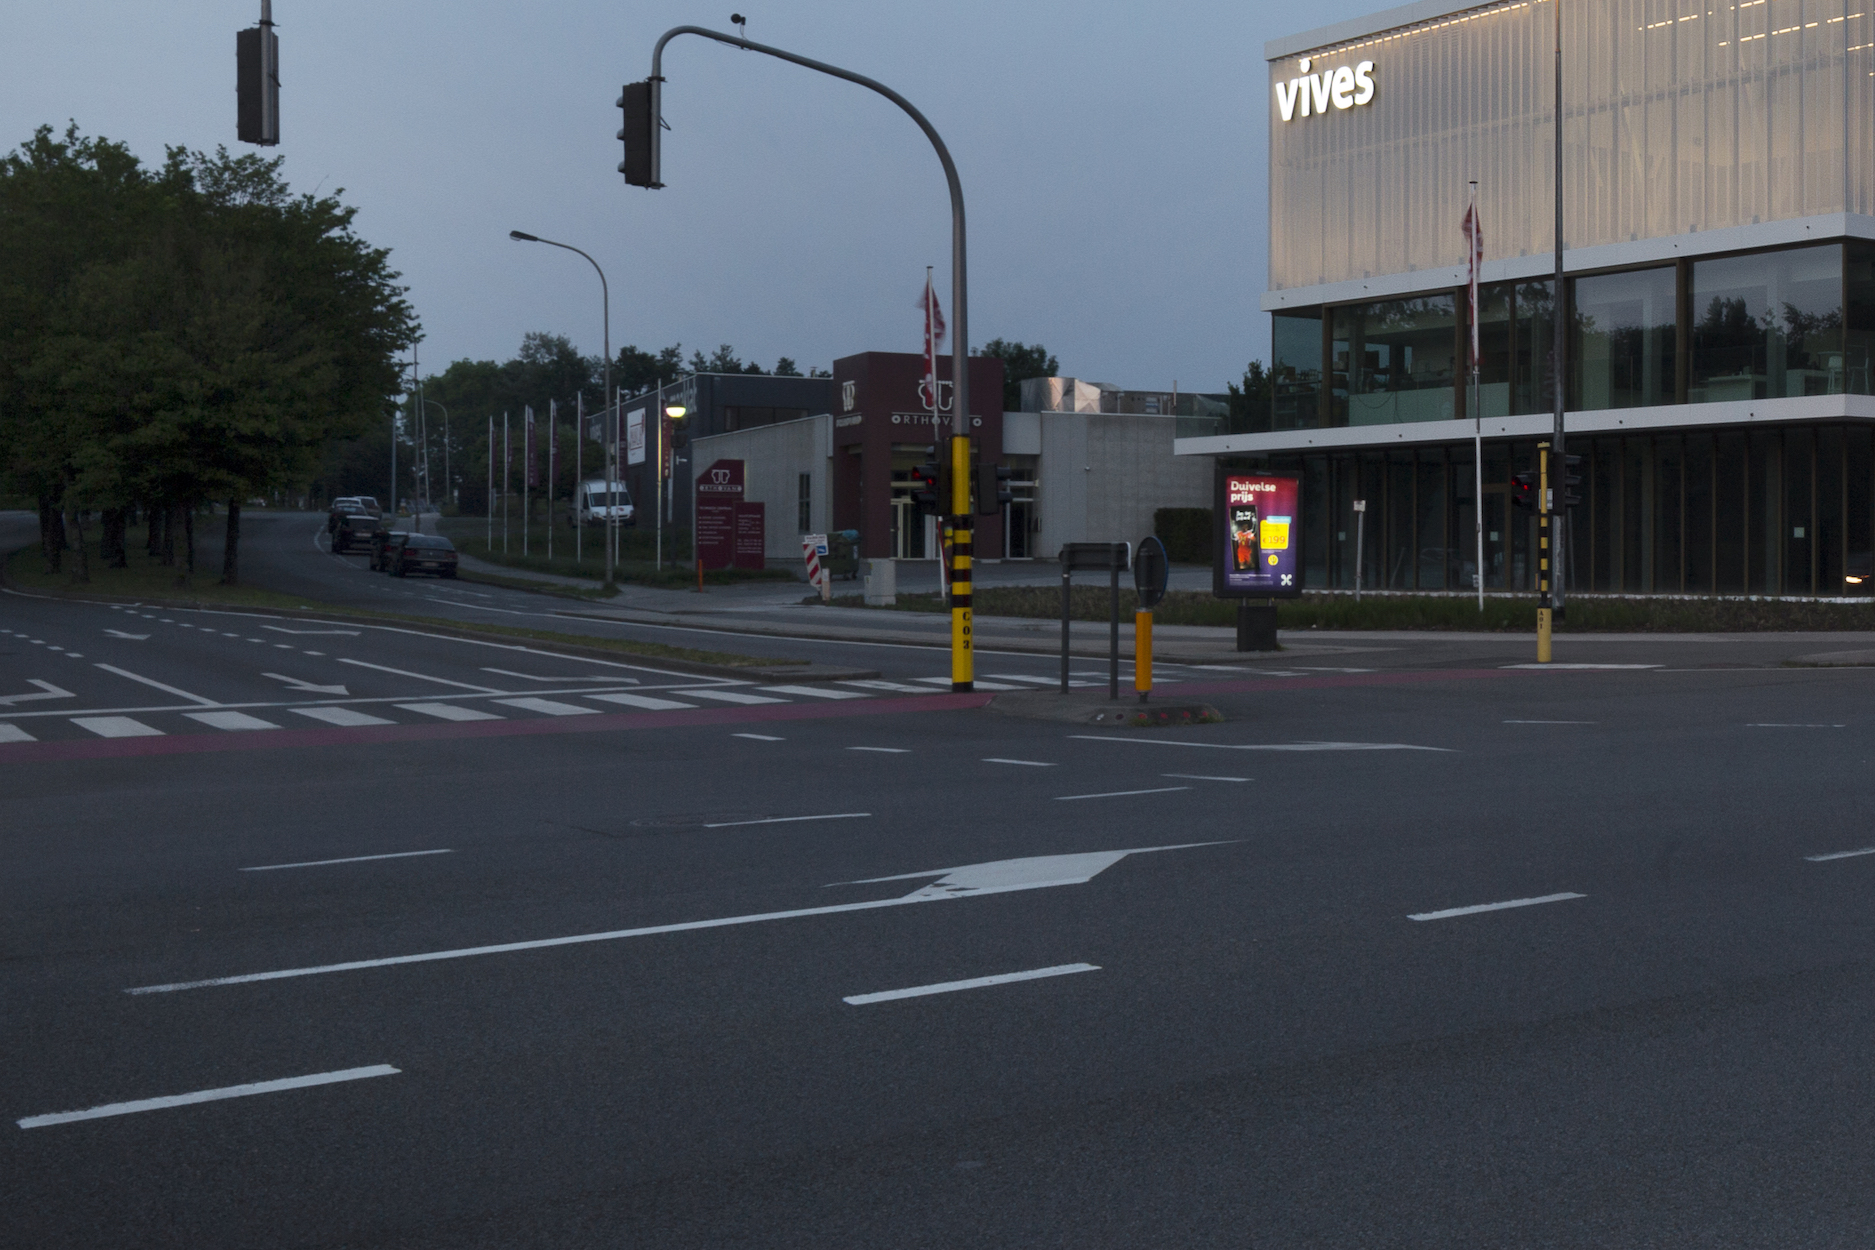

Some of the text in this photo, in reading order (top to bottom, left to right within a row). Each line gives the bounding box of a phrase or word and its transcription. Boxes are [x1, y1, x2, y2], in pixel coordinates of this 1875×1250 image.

[1275, 57, 1376, 123] vives
[891, 414, 982, 427] ORTHOVO
[1230, 481, 1277, 492] Duivelse
[1230, 491, 1255, 503] prijs
